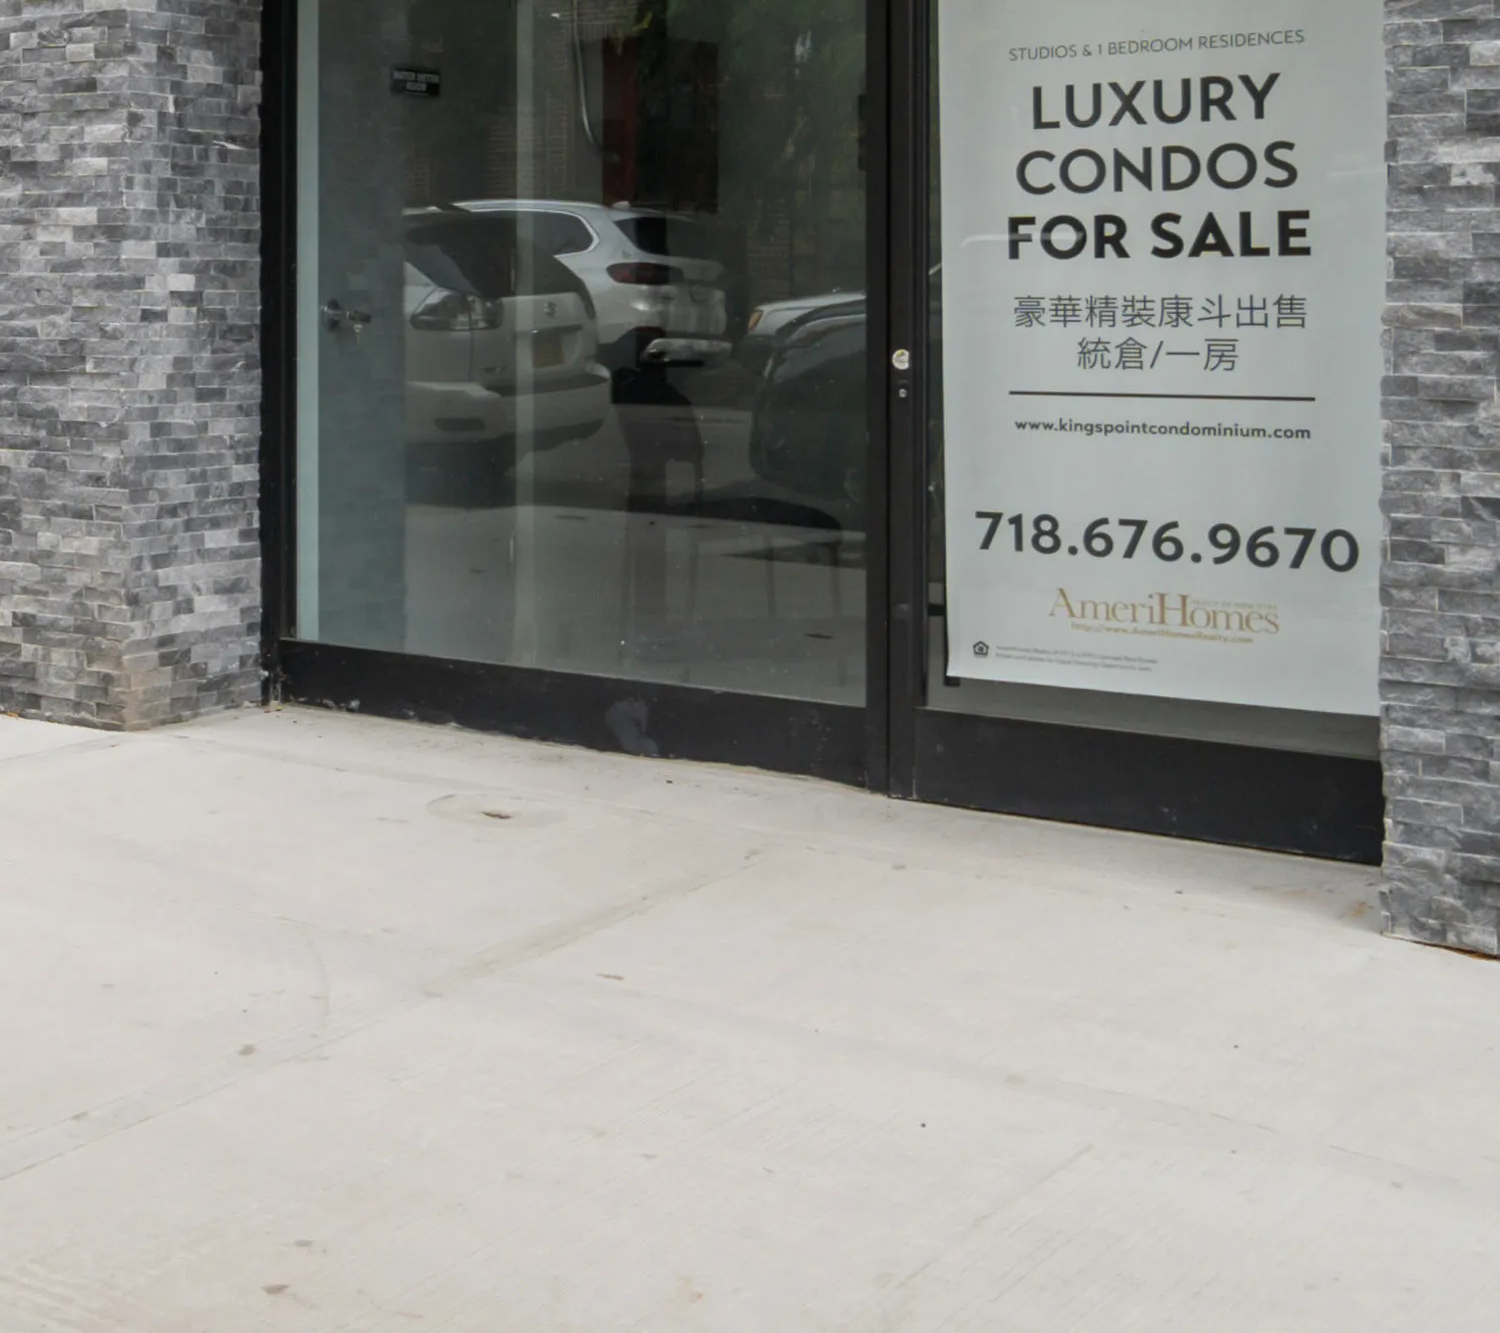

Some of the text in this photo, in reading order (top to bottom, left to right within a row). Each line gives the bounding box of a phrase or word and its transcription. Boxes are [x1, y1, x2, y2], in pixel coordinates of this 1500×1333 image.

[1008, 29, 1305, 61] STUDIOS & 1 BEDROOM RESIDENCES
[1032, 72, 1281, 130] LUXURY
[1016, 141, 1298, 194] CONDOS
[1007, 209, 1312, 260] FOR SALE
[1013, 294, 1307, 329] 豪華精裝康斗出售
[1076, 336, 1239, 371] 統倉/一房
[1014, 418, 1312, 440] www.kingspointcondominium.com
[974, 510, 1360, 573] 718.676.9670
[1049, 587, 1280, 635] AmeriHomes
